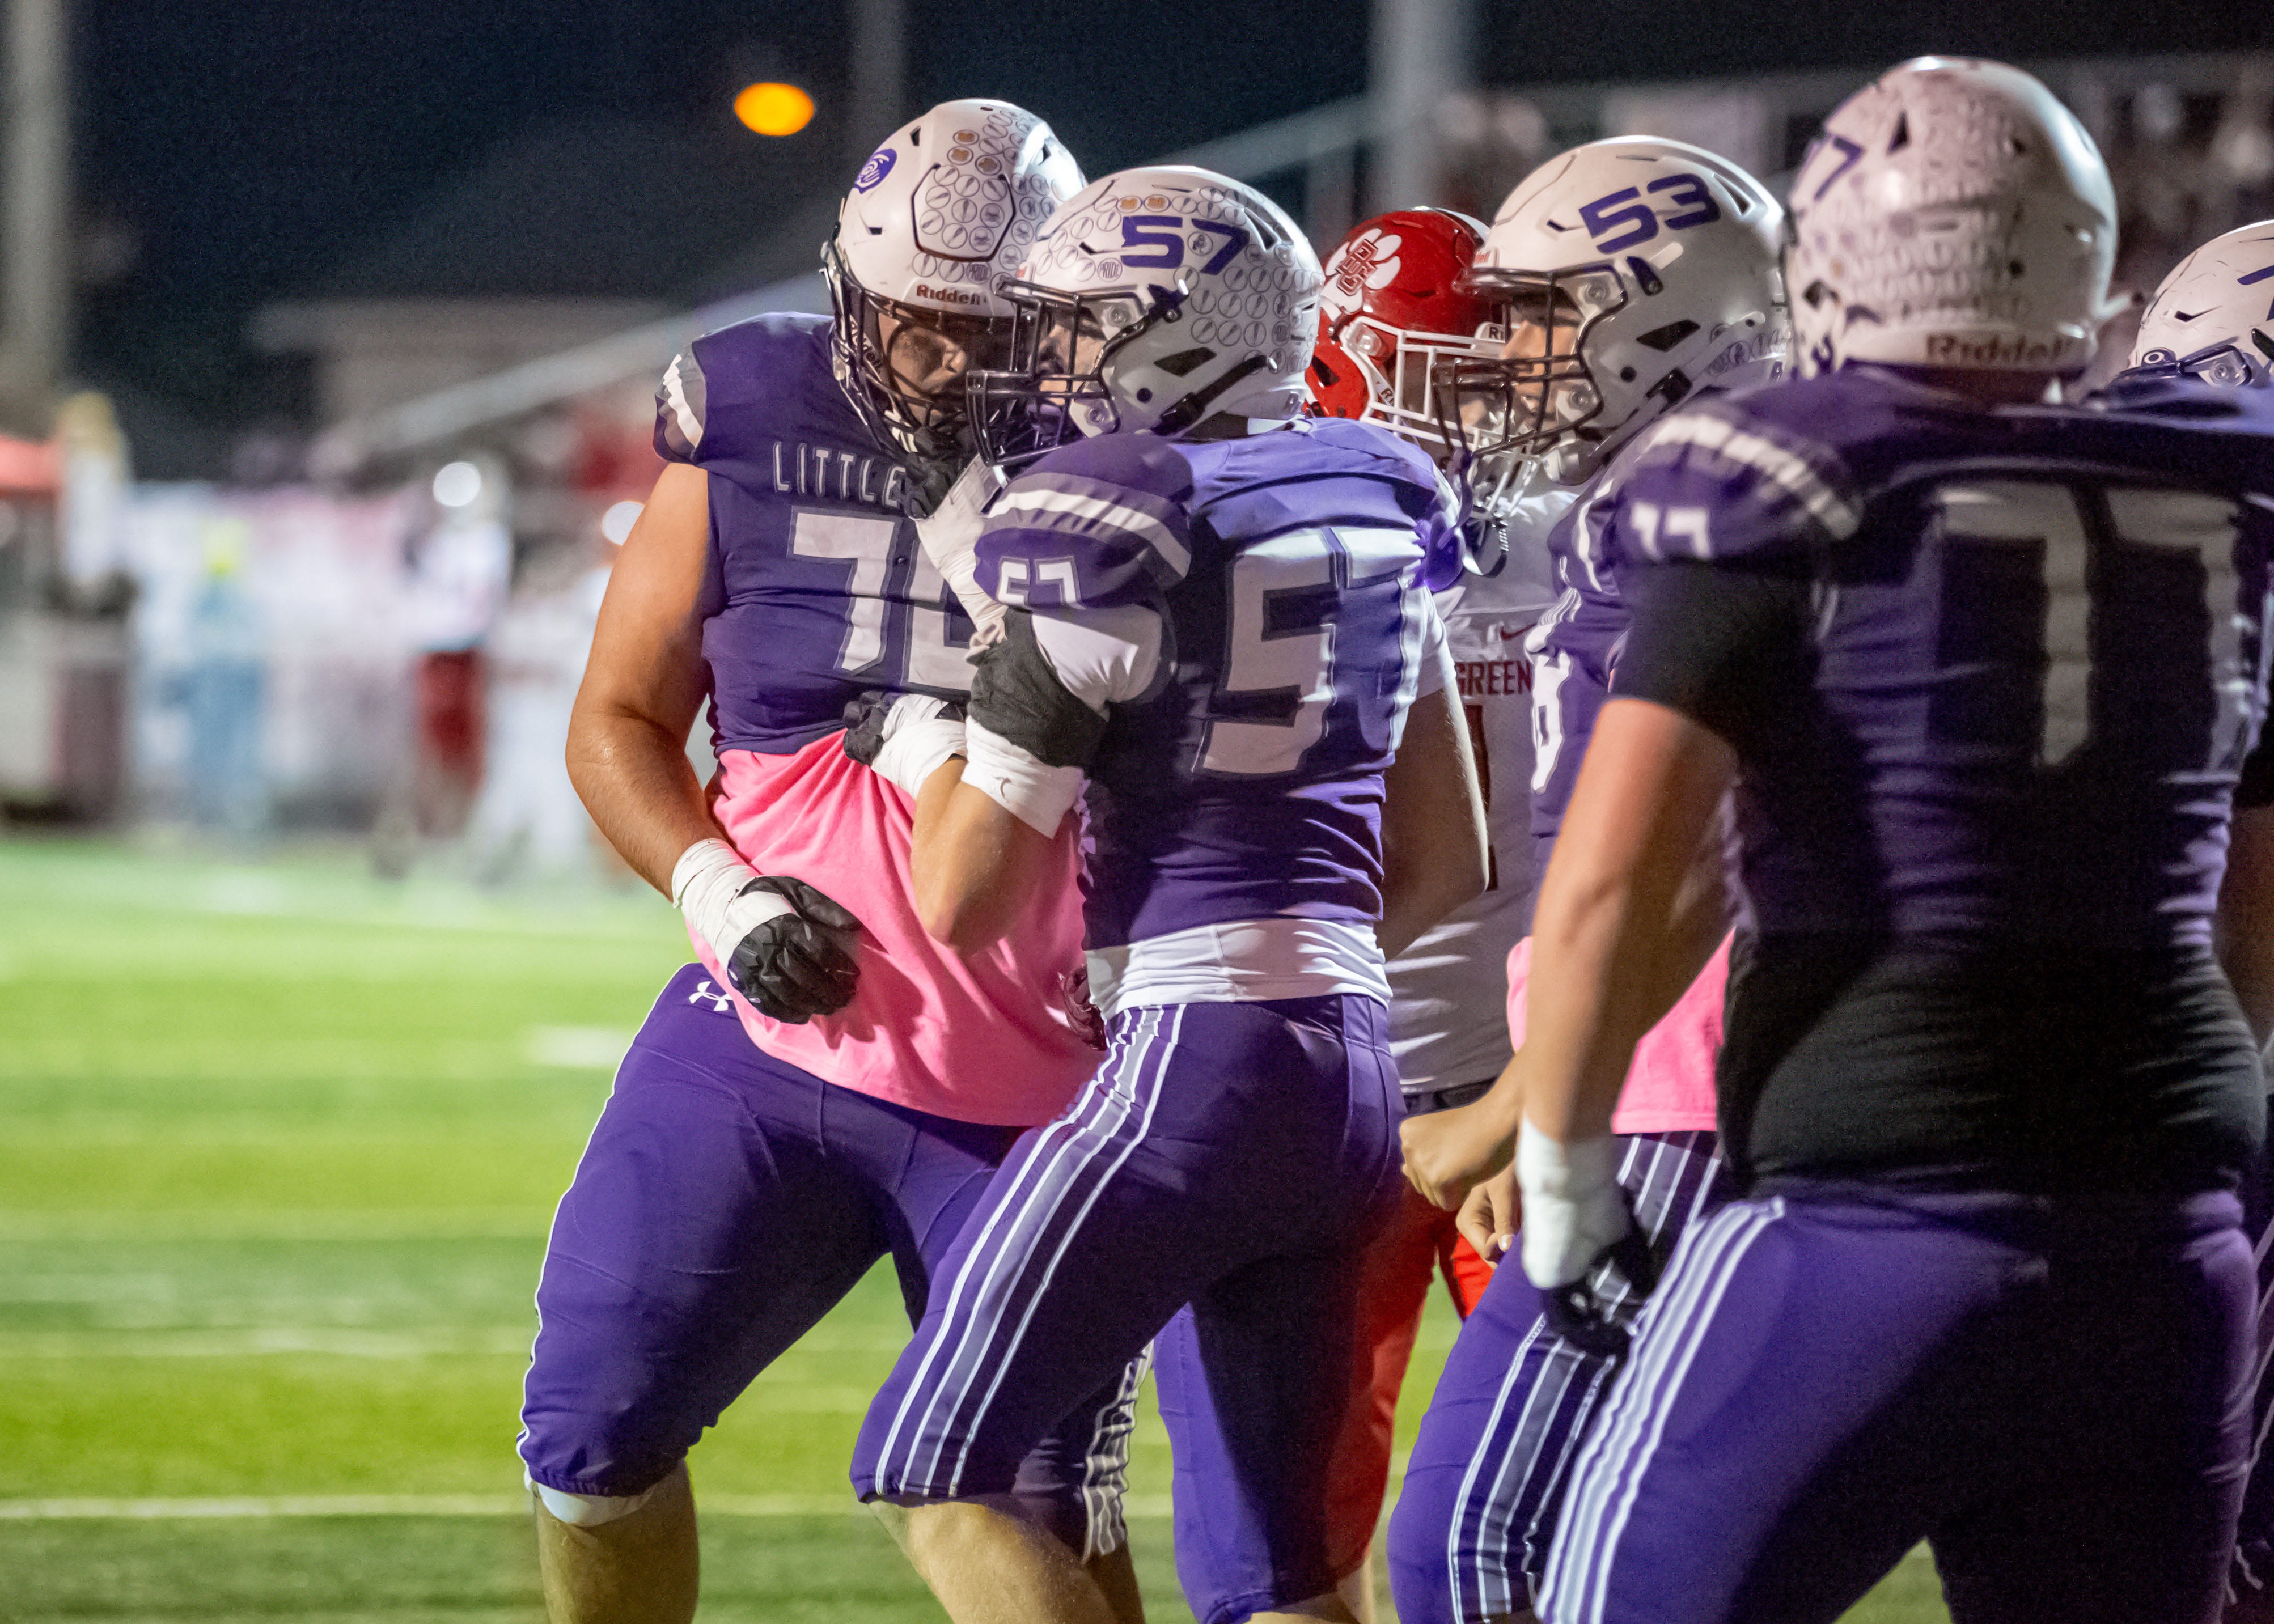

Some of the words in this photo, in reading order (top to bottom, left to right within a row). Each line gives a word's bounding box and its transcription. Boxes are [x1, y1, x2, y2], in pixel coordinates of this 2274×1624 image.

[1120, 215, 1250, 275] 57
[1579, 173, 1721, 255] 53
[773, 441, 909, 508] LITTLE
[1629, 501, 1712, 559] 77
[1192, 525, 1425, 779] 57
[1930, 480, 2245, 771] 77
[1454, 660, 1534, 696] GREEN
